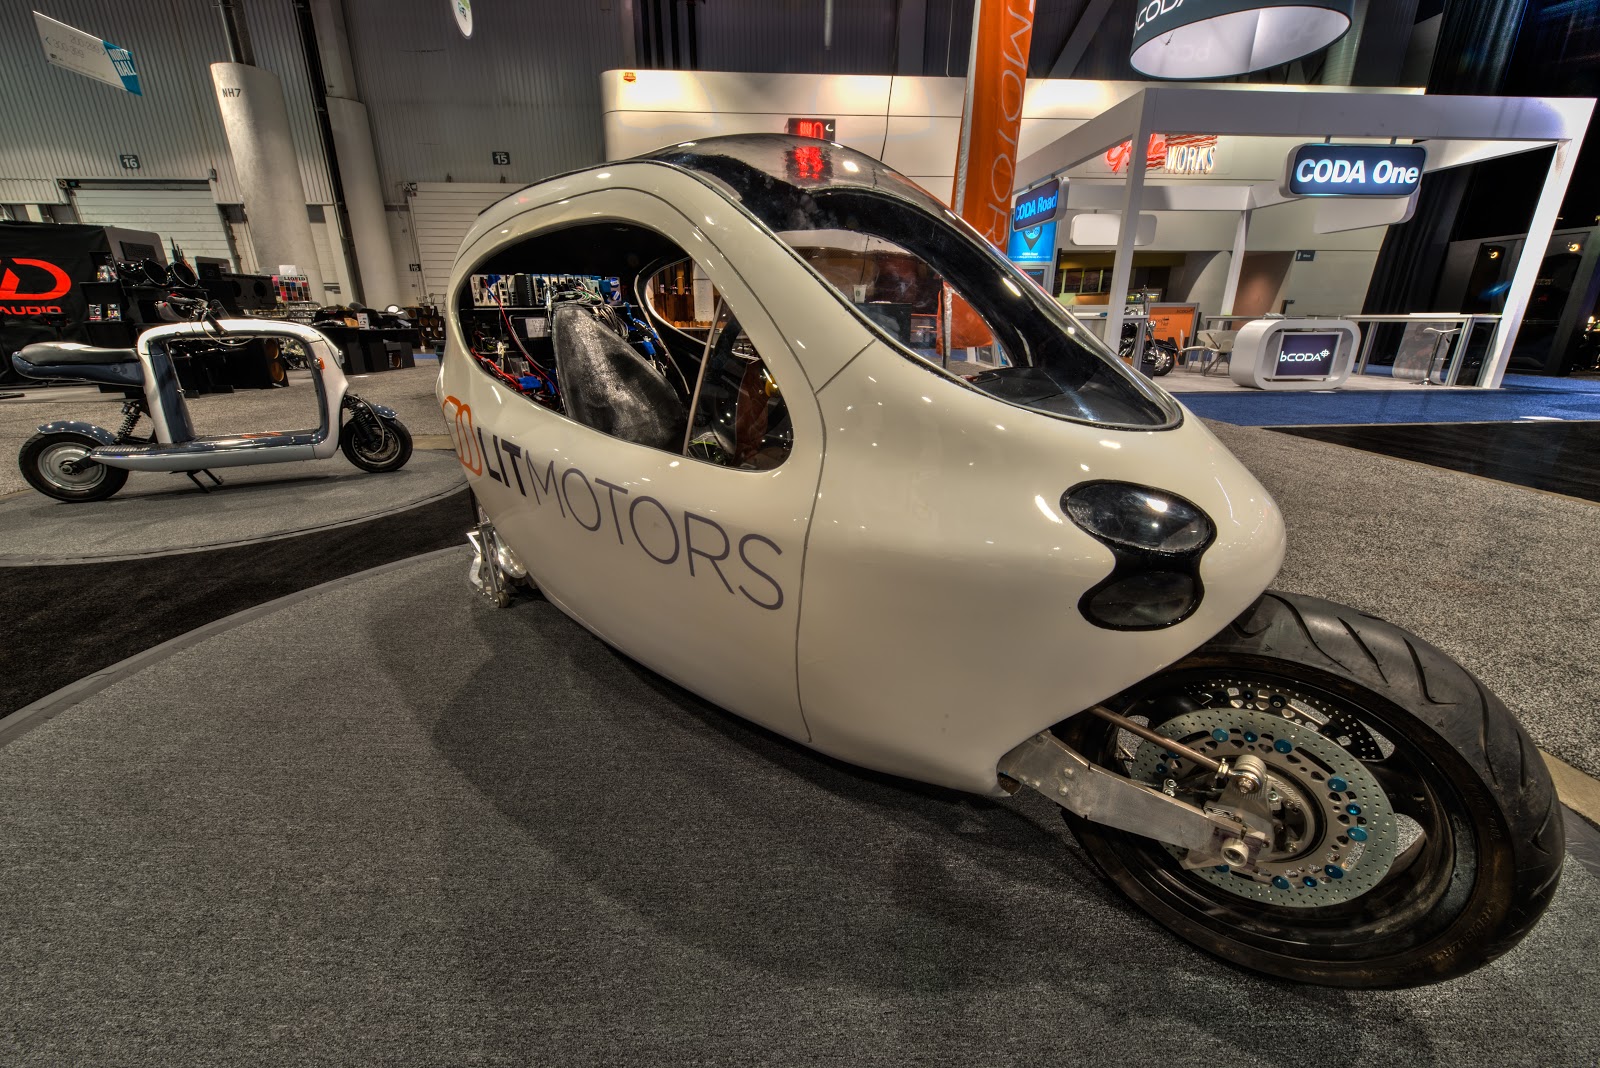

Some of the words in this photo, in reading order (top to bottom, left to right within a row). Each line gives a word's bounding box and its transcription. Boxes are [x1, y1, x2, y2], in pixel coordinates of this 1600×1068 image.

[114, 60, 137, 76] HALL
[222, 88, 241, 98] NH7
[123, 158, 138, 168] 16
[495, 155, 508, 164] 15
[1165, 145, 1217, 171] WORKS
[1296, 159, 1366, 183] CODA
[1372, 160, 1420, 184] One
[1015, 199, 1037, 222] CODA
[1037, 190, 1059, 214] Road
[1279, 350, 1322, 362] bCODA
